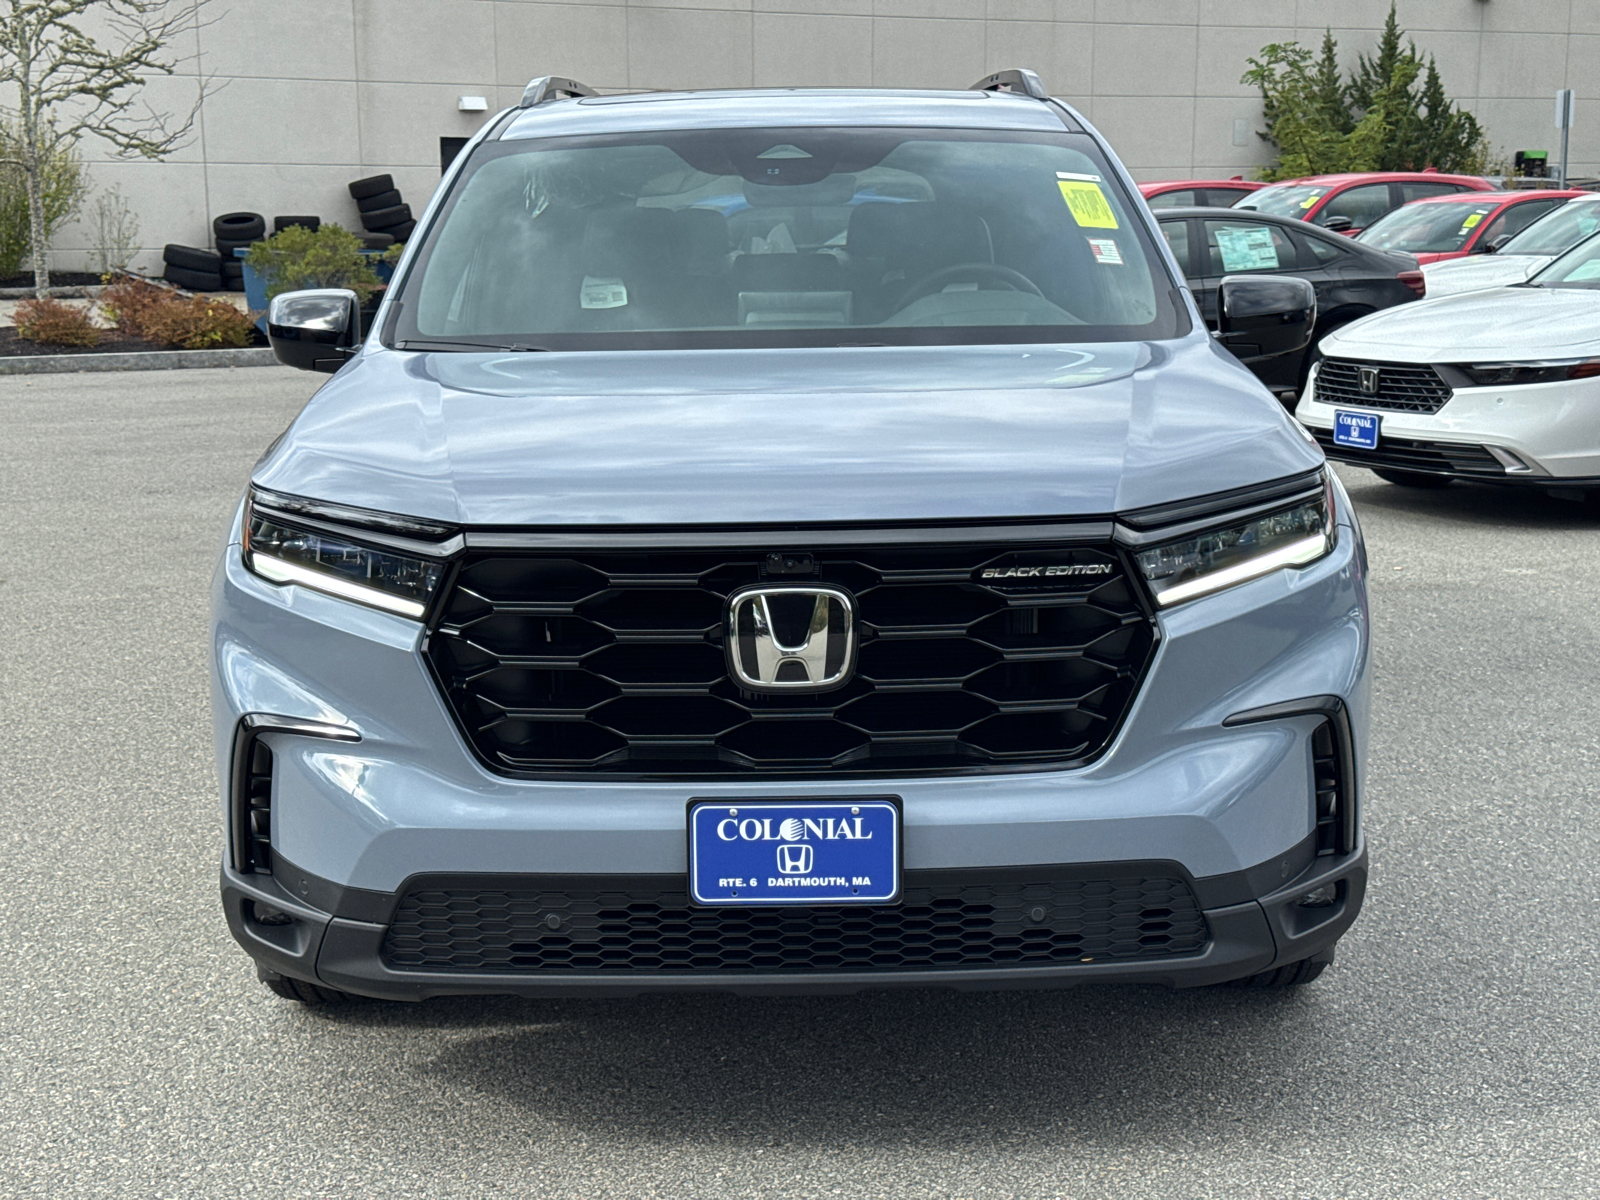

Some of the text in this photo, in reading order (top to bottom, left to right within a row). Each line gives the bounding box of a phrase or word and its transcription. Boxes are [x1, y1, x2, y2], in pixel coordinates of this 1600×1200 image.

[981, 564, 1112, 578] BLACK EDITION
[717, 818, 872, 841] COLONIAL
[719, 876, 871, 888] RTE. 6 DARTMOUTH, MA
